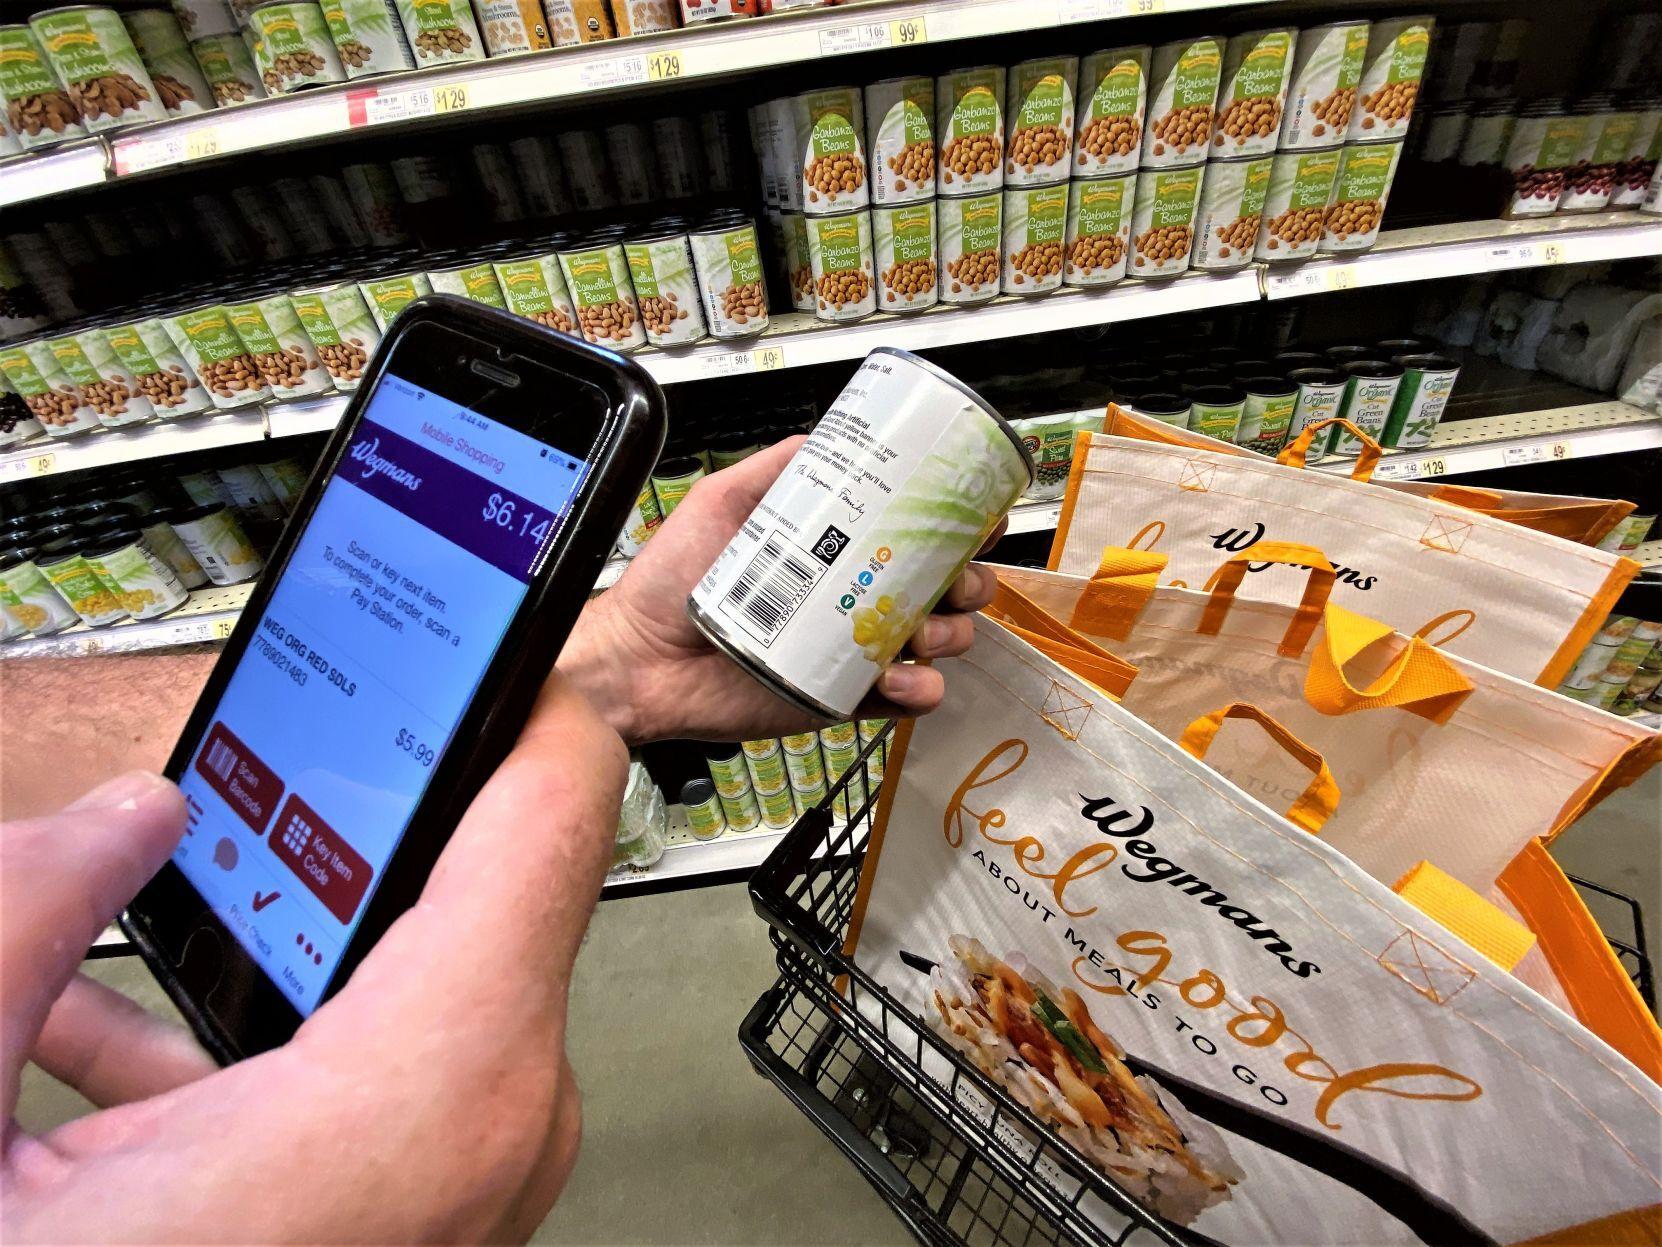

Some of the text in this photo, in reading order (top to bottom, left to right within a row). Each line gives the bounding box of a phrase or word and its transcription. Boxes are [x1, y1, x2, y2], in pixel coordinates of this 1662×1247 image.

[1243, 80, 1275, 95] Beans
[1183, 90, 1211, 104] Beans
[953, 105, 997, 120] Garbanzo
[1101, 100, 1131, 113] Beans
[1025, 110, 1056, 124] Beans
[812, 123, 855, 139] Garbanzo
[960, 119, 990, 133] Beans
[819, 139, 850, 152] Beans
[1079, 207, 1120, 222] Garbanzo
[1160, 211, 1188, 224] Beans
[1085, 220, 1114, 233] Beans
[893, 234, 931, 248] Garbanzo
[1034, 229, 1060, 241] Beans
[968, 237, 995, 250] Beans
[821, 244, 860, 258] Garbanzo
[901, 247, 928, 260] Beans
[827, 256, 855, 269] Beans
[575, 277, 615, 293] Cannellini
[509, 286, 549, 301] Cannellini
[584, 291, 611, 303] Beans
[518, 300, 546, 313] Beans
[207, 346, 241, 360] Beans
[1358, 386, 1393, 400] Organic
[1303, 394, 1337, 408] Organic
[1355, 416, 1382, 424] Beans
[1357, 409, 1384, 417] Green
[476, 418, 489, 431] AM
[847, 414, 871, 430] Artificial
[420, 421, 506, 474] Mobile Shopping
[846, 434, 858, 444] with
[857, 440, 866, 448] no
[883, 447, 899, 459] your
[351, 438, 424, 492] Wegmans
[831, 461, 849, 474] money
[862, 470, 880, 484] you'll
[878, 481, 893, 494] love
[837, 487, 866, 523] Family
[482, 492, 550, 546] $6.14
[777, 516, 794, 530] ADDED
[868, 562, 880, 573] FREE
[347, 540, 448, 614] Scan or key next item.
[850, 580, 868, 595] LACTOSE
[850, 588, 861, 597] FREE
[323, 547, 461, 646] To complete your order, scan a
[351, 587, 405, 634] Pay Station.
[834, 605, 848, 617] VEGAN
[773, 605, 794, 631] 77890
[263, 617, 357, 697] WEG ORG RED SDLS
[394, 727, 435, 767] $5.99
[236, 761, 260, 789] Scan
[228, 779, 263, 818] Barcode
[312, 835, 353, 881] Key Item
[303, 855, 329, 886] Code
[1078, 792, 1322, 980] Wegmans
[943, 738, 1483, 1131] feel good
[282, 966, 305, 995] More
[971, 849, 1290, 1108] ABOUT MEALS TO GO
[958, 1083, 985, 1109] PICY
